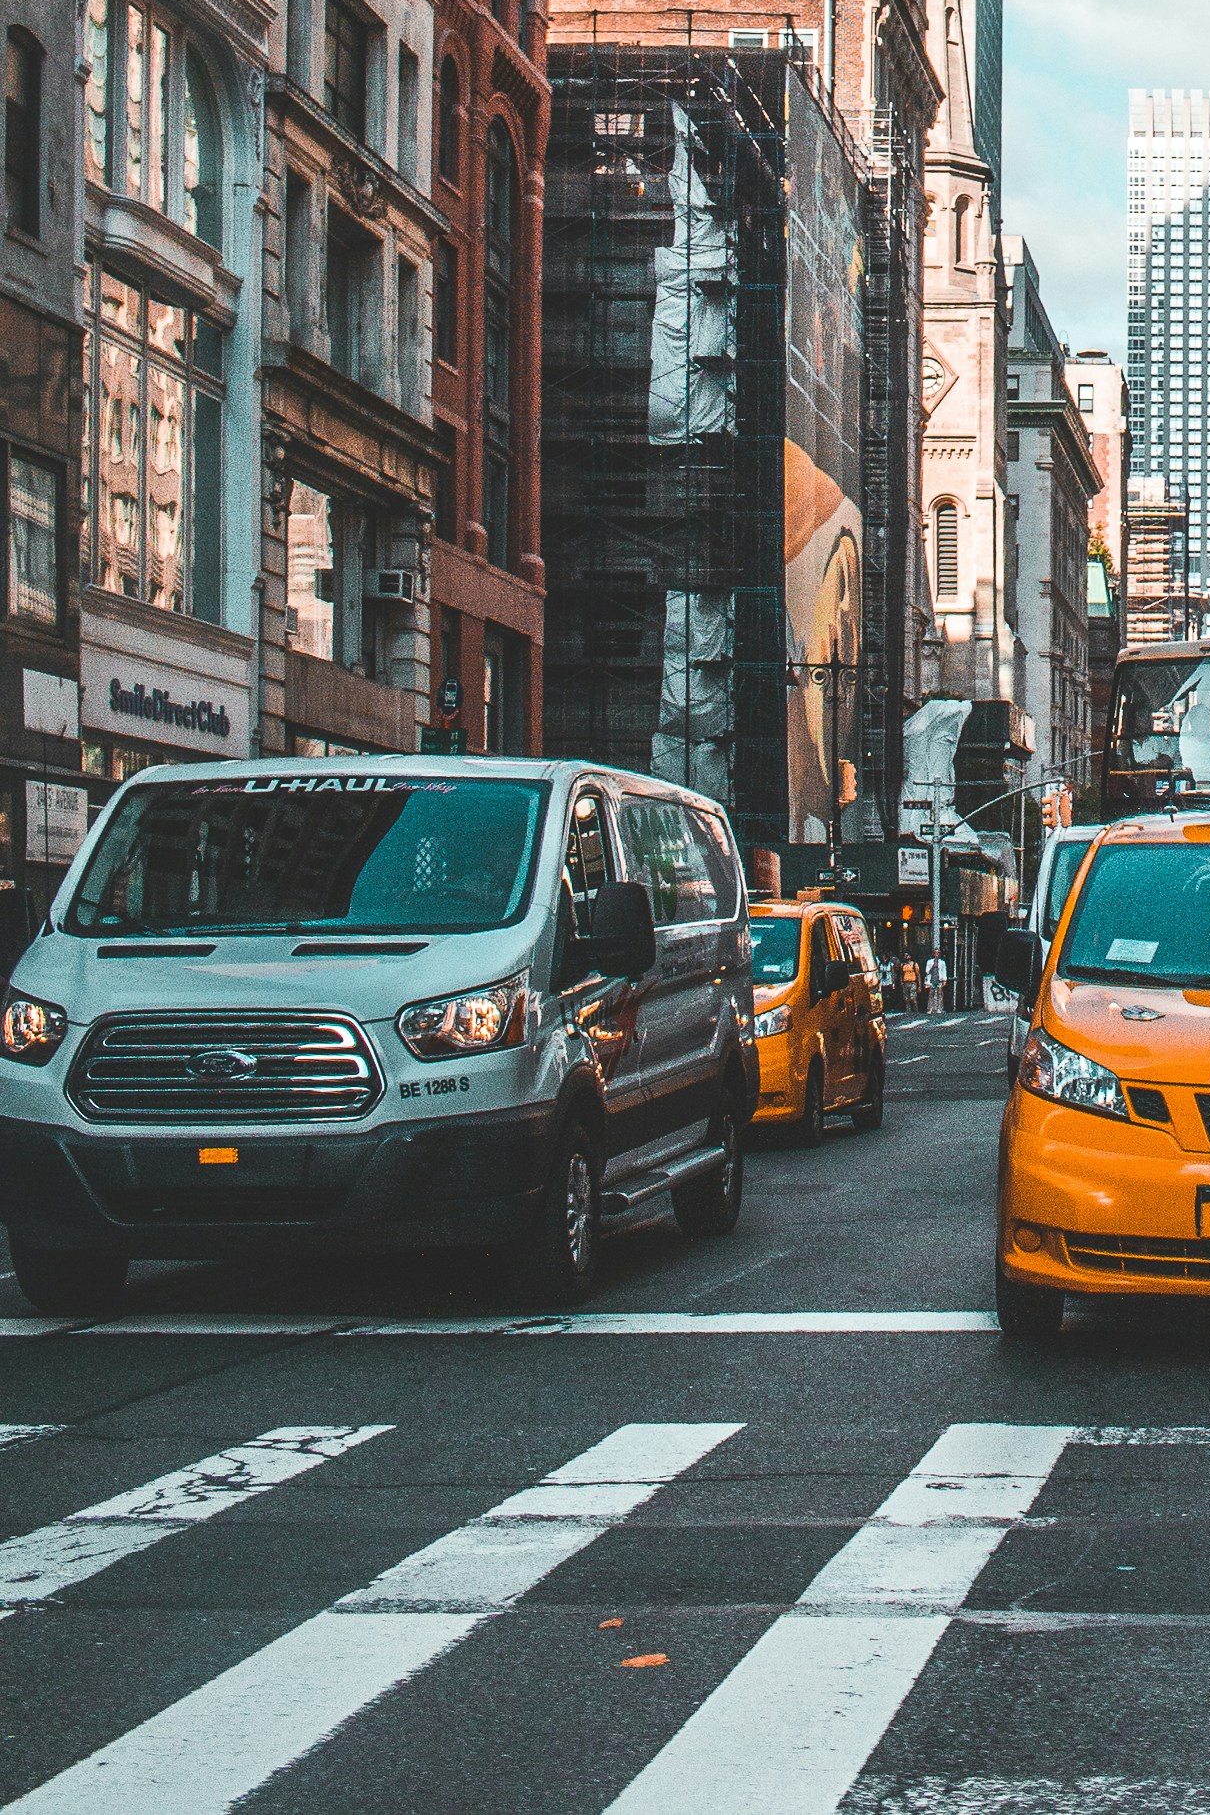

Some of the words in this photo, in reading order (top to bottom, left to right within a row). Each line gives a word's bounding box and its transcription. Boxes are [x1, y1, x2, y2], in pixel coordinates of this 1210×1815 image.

[109, 677, 230, 738] SmileDirectClub
[243, 778, 395, 793] U-HAUL
[400, 1081, 421, 1099] BE
[424, 1078, 457, 1095] 1288
[459, 1076, 470, 1092] S
